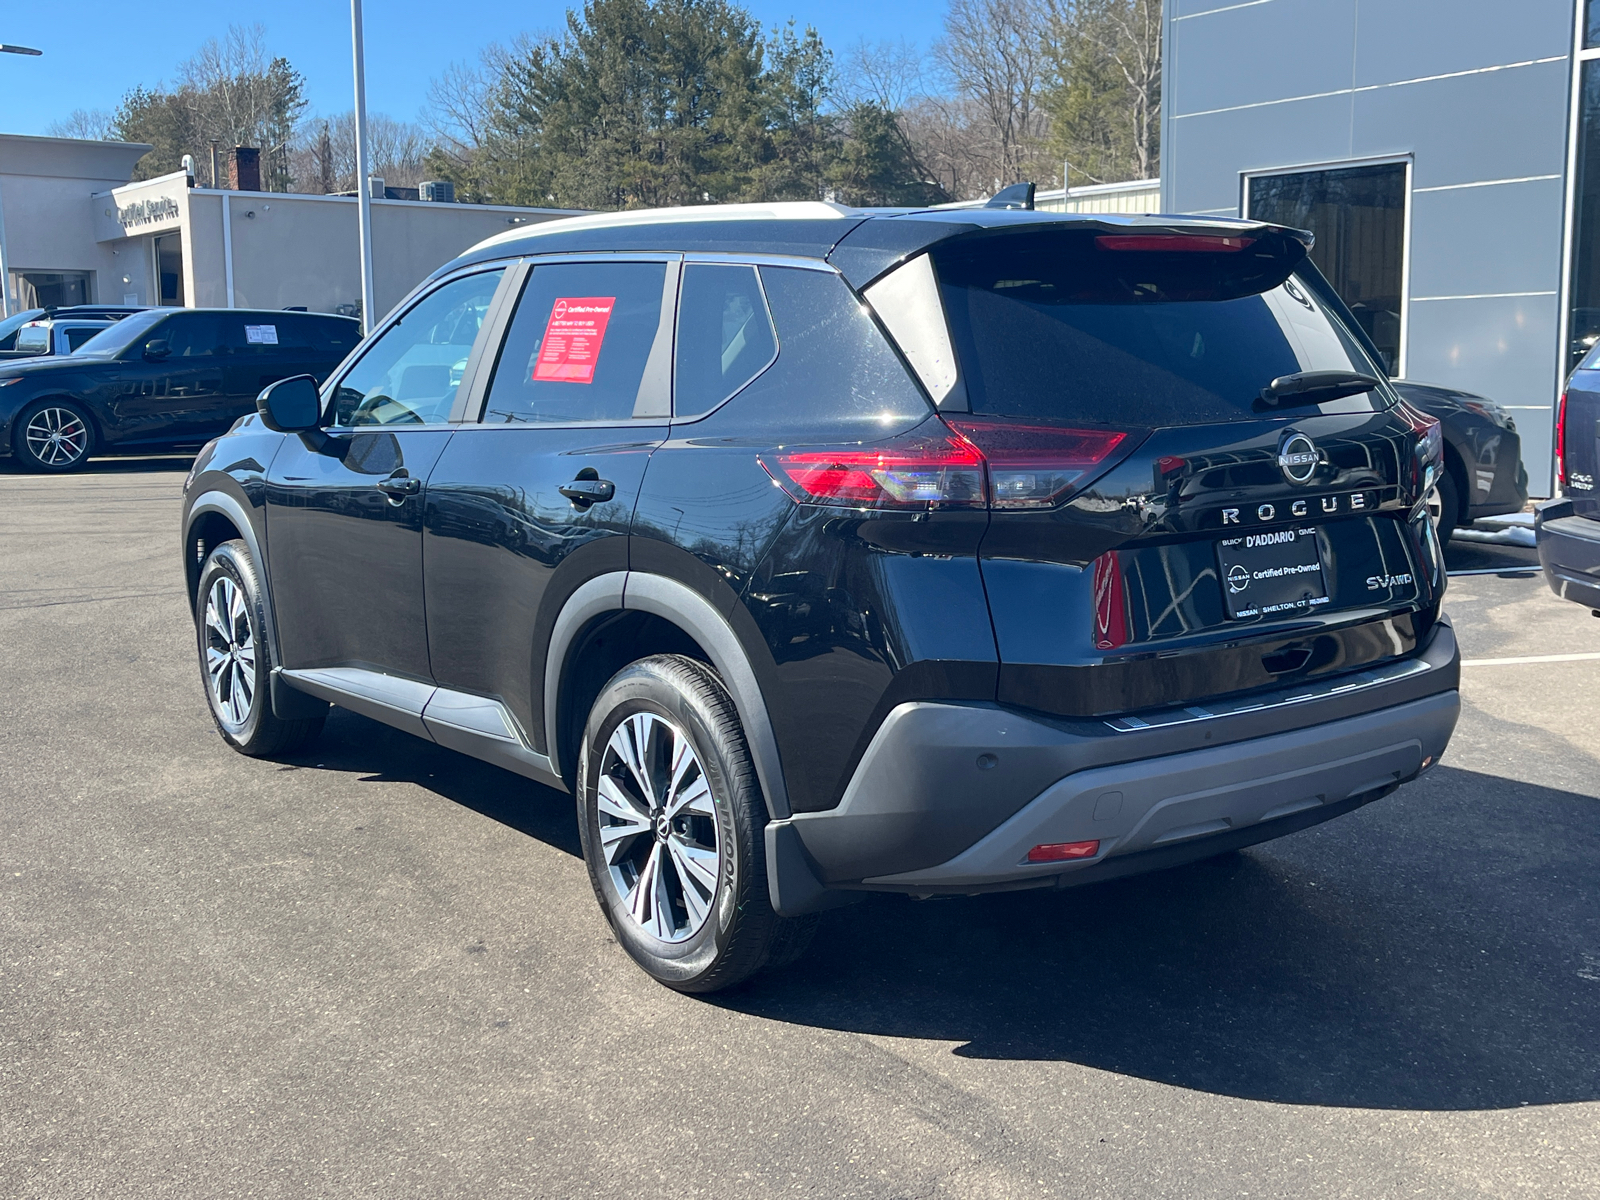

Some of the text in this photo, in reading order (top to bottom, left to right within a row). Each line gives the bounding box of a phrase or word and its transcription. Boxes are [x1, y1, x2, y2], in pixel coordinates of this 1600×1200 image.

[1280, 453, 1319, 466] NISSAN
[1221, 493, 1365, 525] ROGUE
[1222, 527, 1316, 548] BUICK D'ADDARIO GMC
[1227, 574, 1250, 582] NISSAN
[1253, 562, 1320, 580] Certified Pre-Owned
[1366, 573, 1412, 591] SV AWD
[1236, 608, 1258, 618] NISSAN
